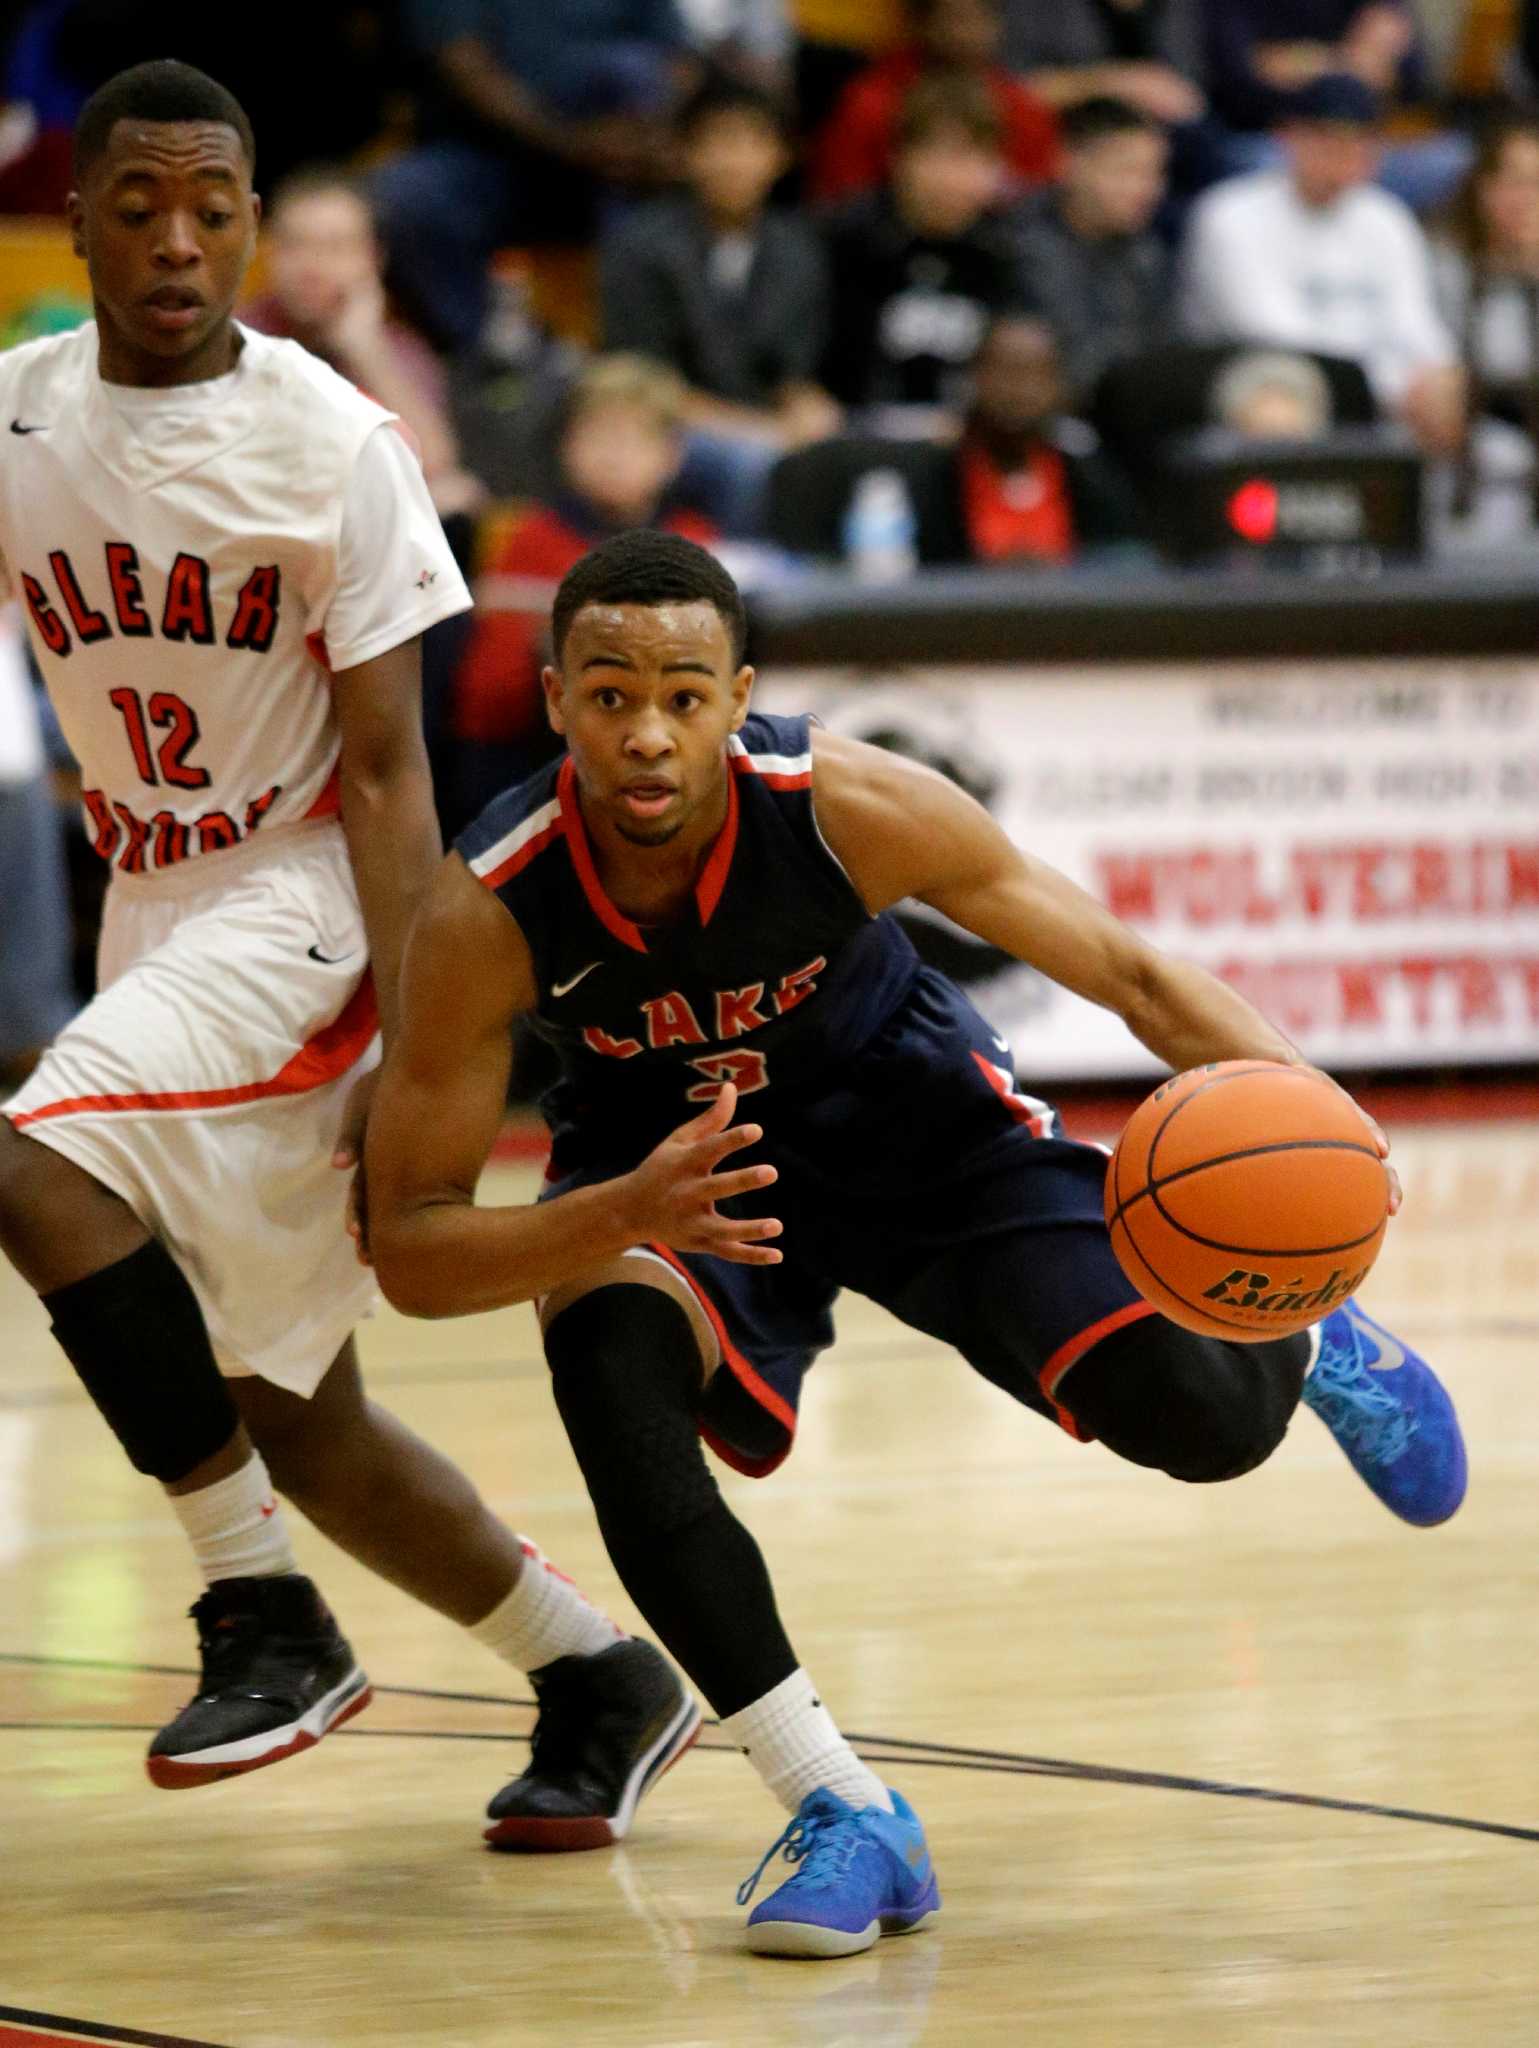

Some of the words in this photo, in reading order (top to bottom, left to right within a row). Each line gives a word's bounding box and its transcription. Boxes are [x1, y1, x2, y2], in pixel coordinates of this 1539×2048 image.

[21, 541, 281, 657] CLEAR
[108, 687, 211, 790] 12
[583, 955, 827, 1059] LAKE
